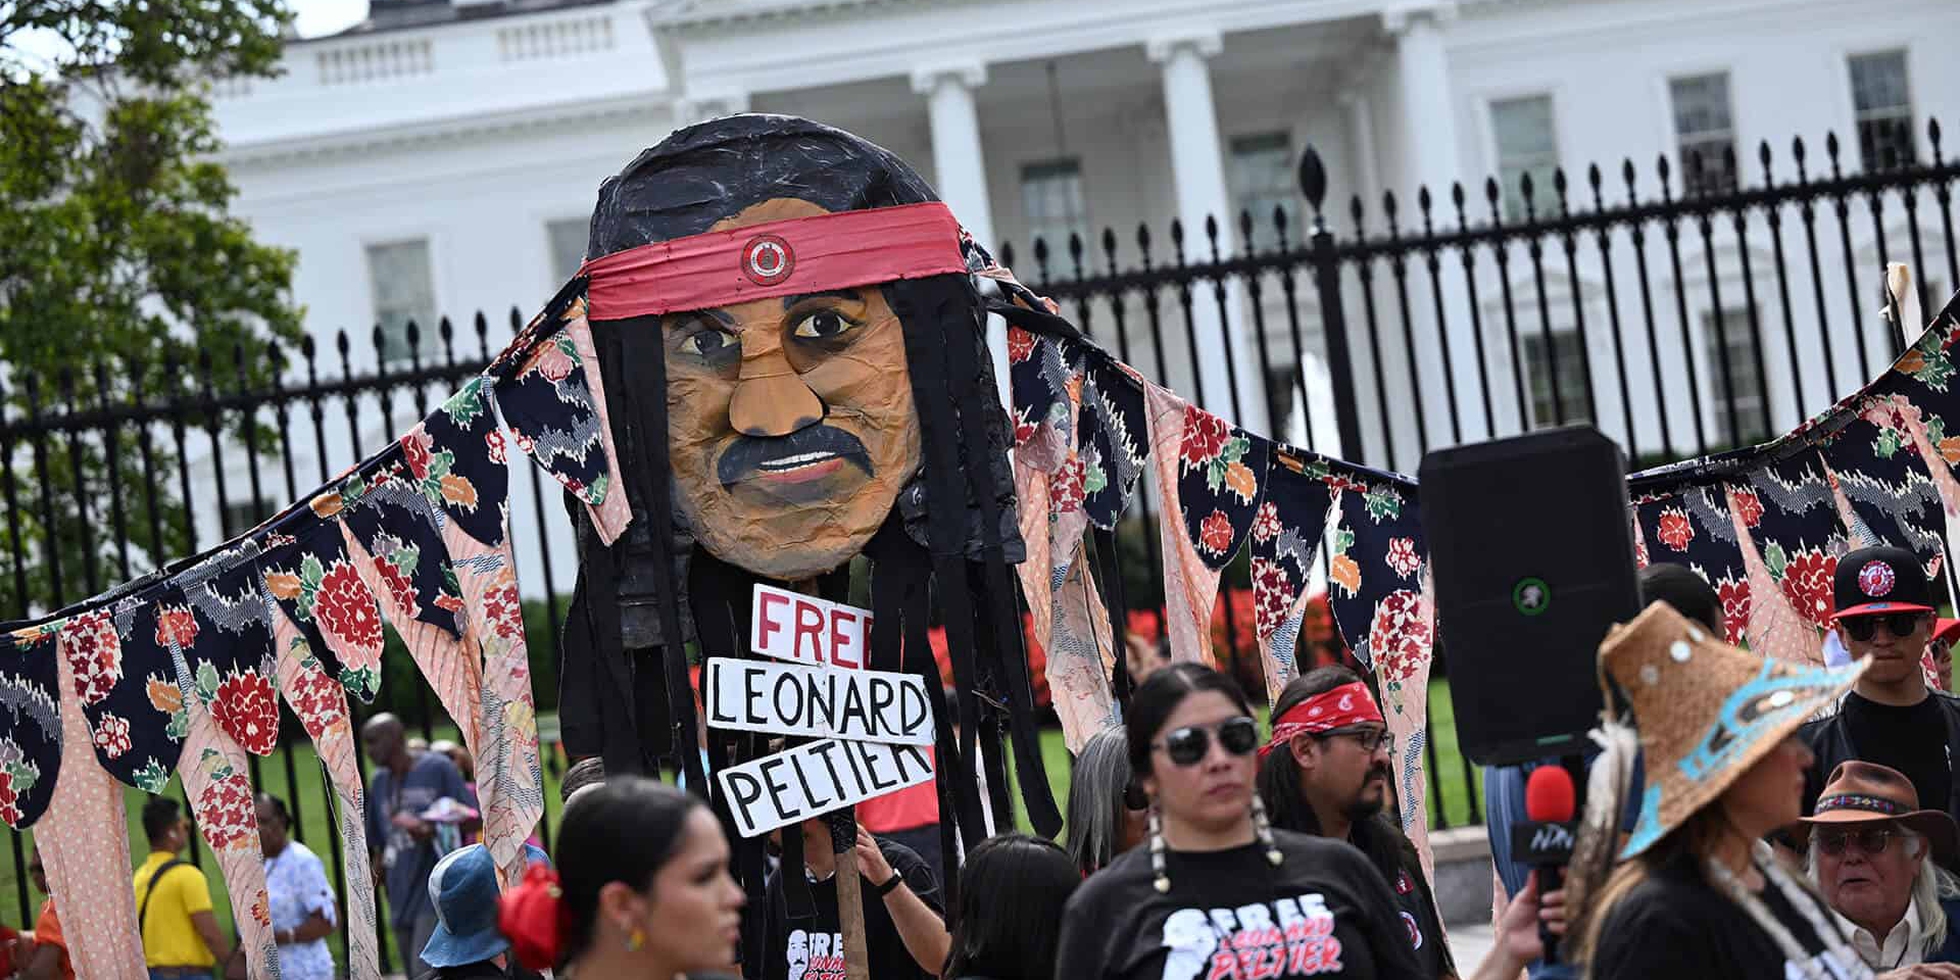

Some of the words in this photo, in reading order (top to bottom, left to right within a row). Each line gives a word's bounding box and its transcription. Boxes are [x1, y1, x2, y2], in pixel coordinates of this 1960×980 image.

[711, 663, 928, 736] LEONARD
[1209, 893, 1334, 937] FREE
[1205, 937, 1342, 980] PELTIER
